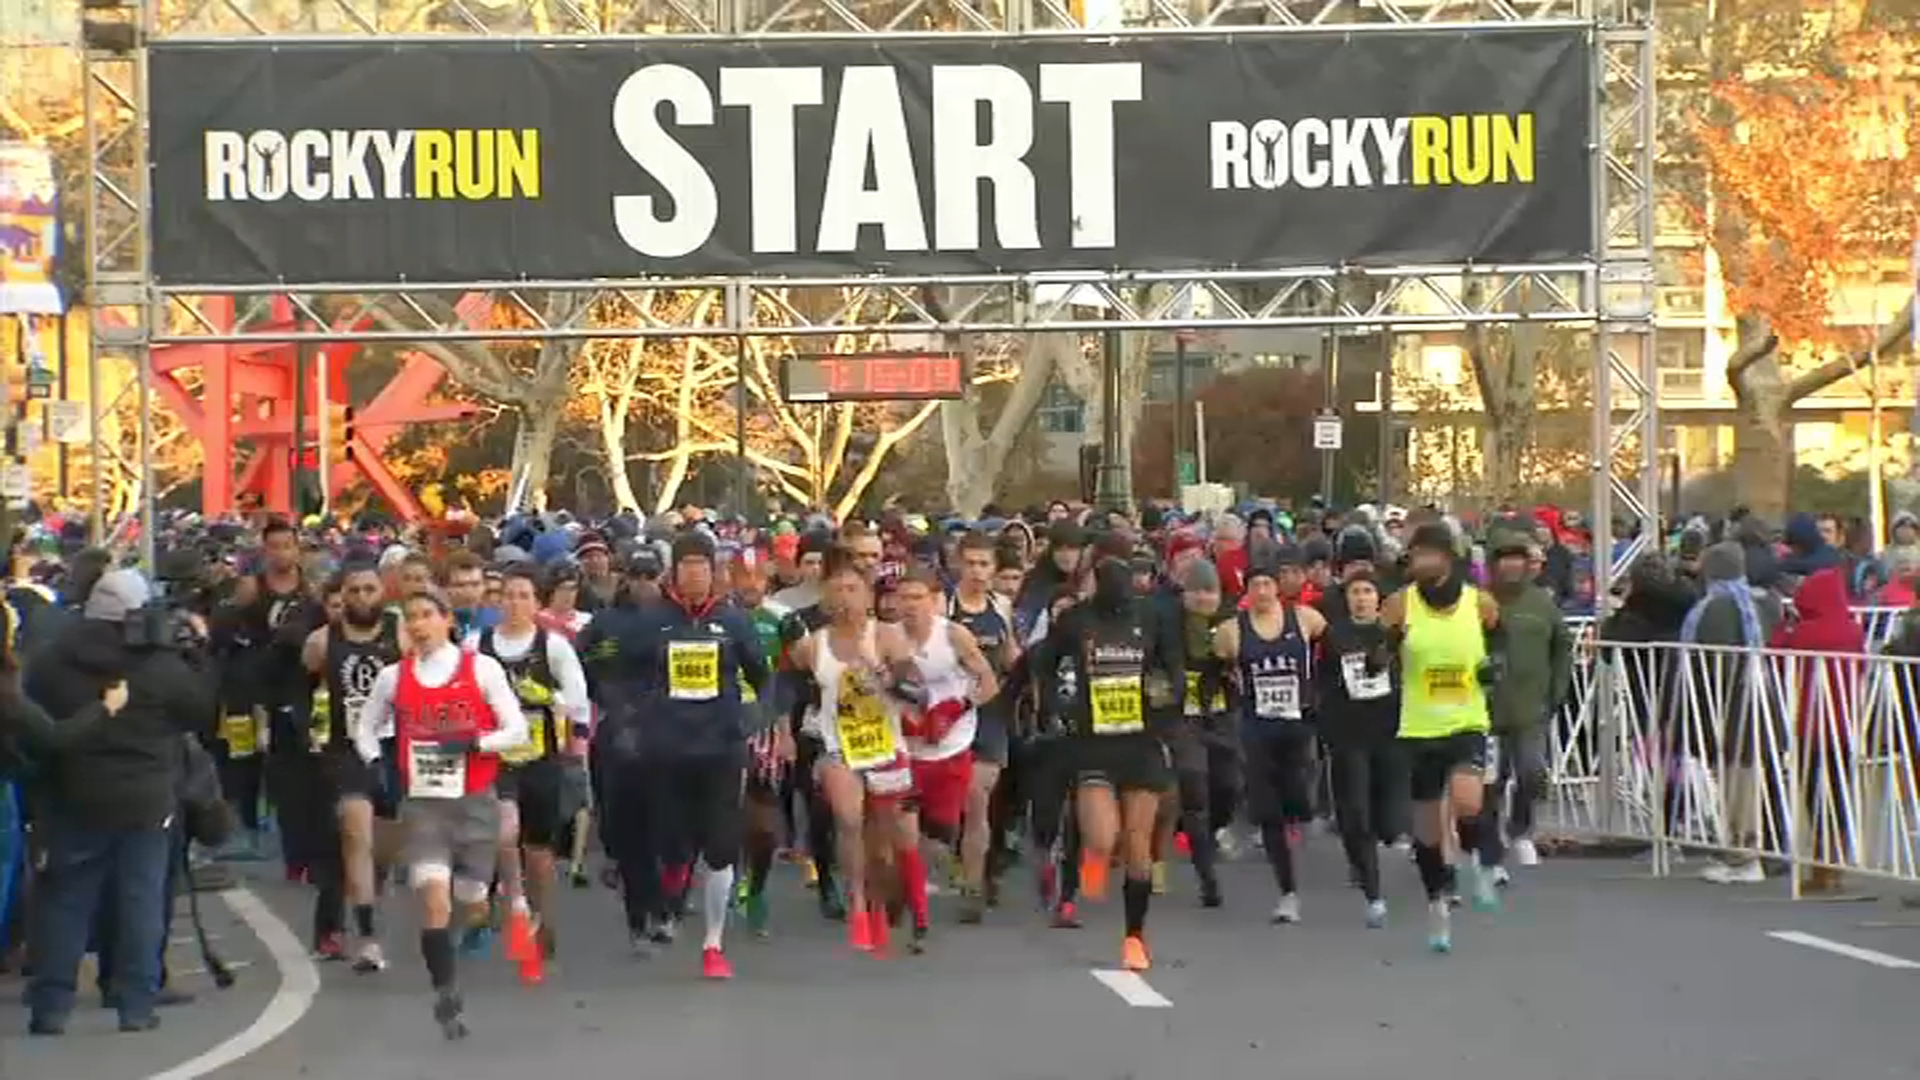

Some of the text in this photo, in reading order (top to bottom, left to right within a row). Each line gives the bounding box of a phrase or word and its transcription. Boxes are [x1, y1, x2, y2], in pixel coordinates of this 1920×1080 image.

[204, 128, 541, 202] ROCKYRUN
[612, 62, 1143, 258] START
[1209, 113, 1536, 190] ROCKYRUN
